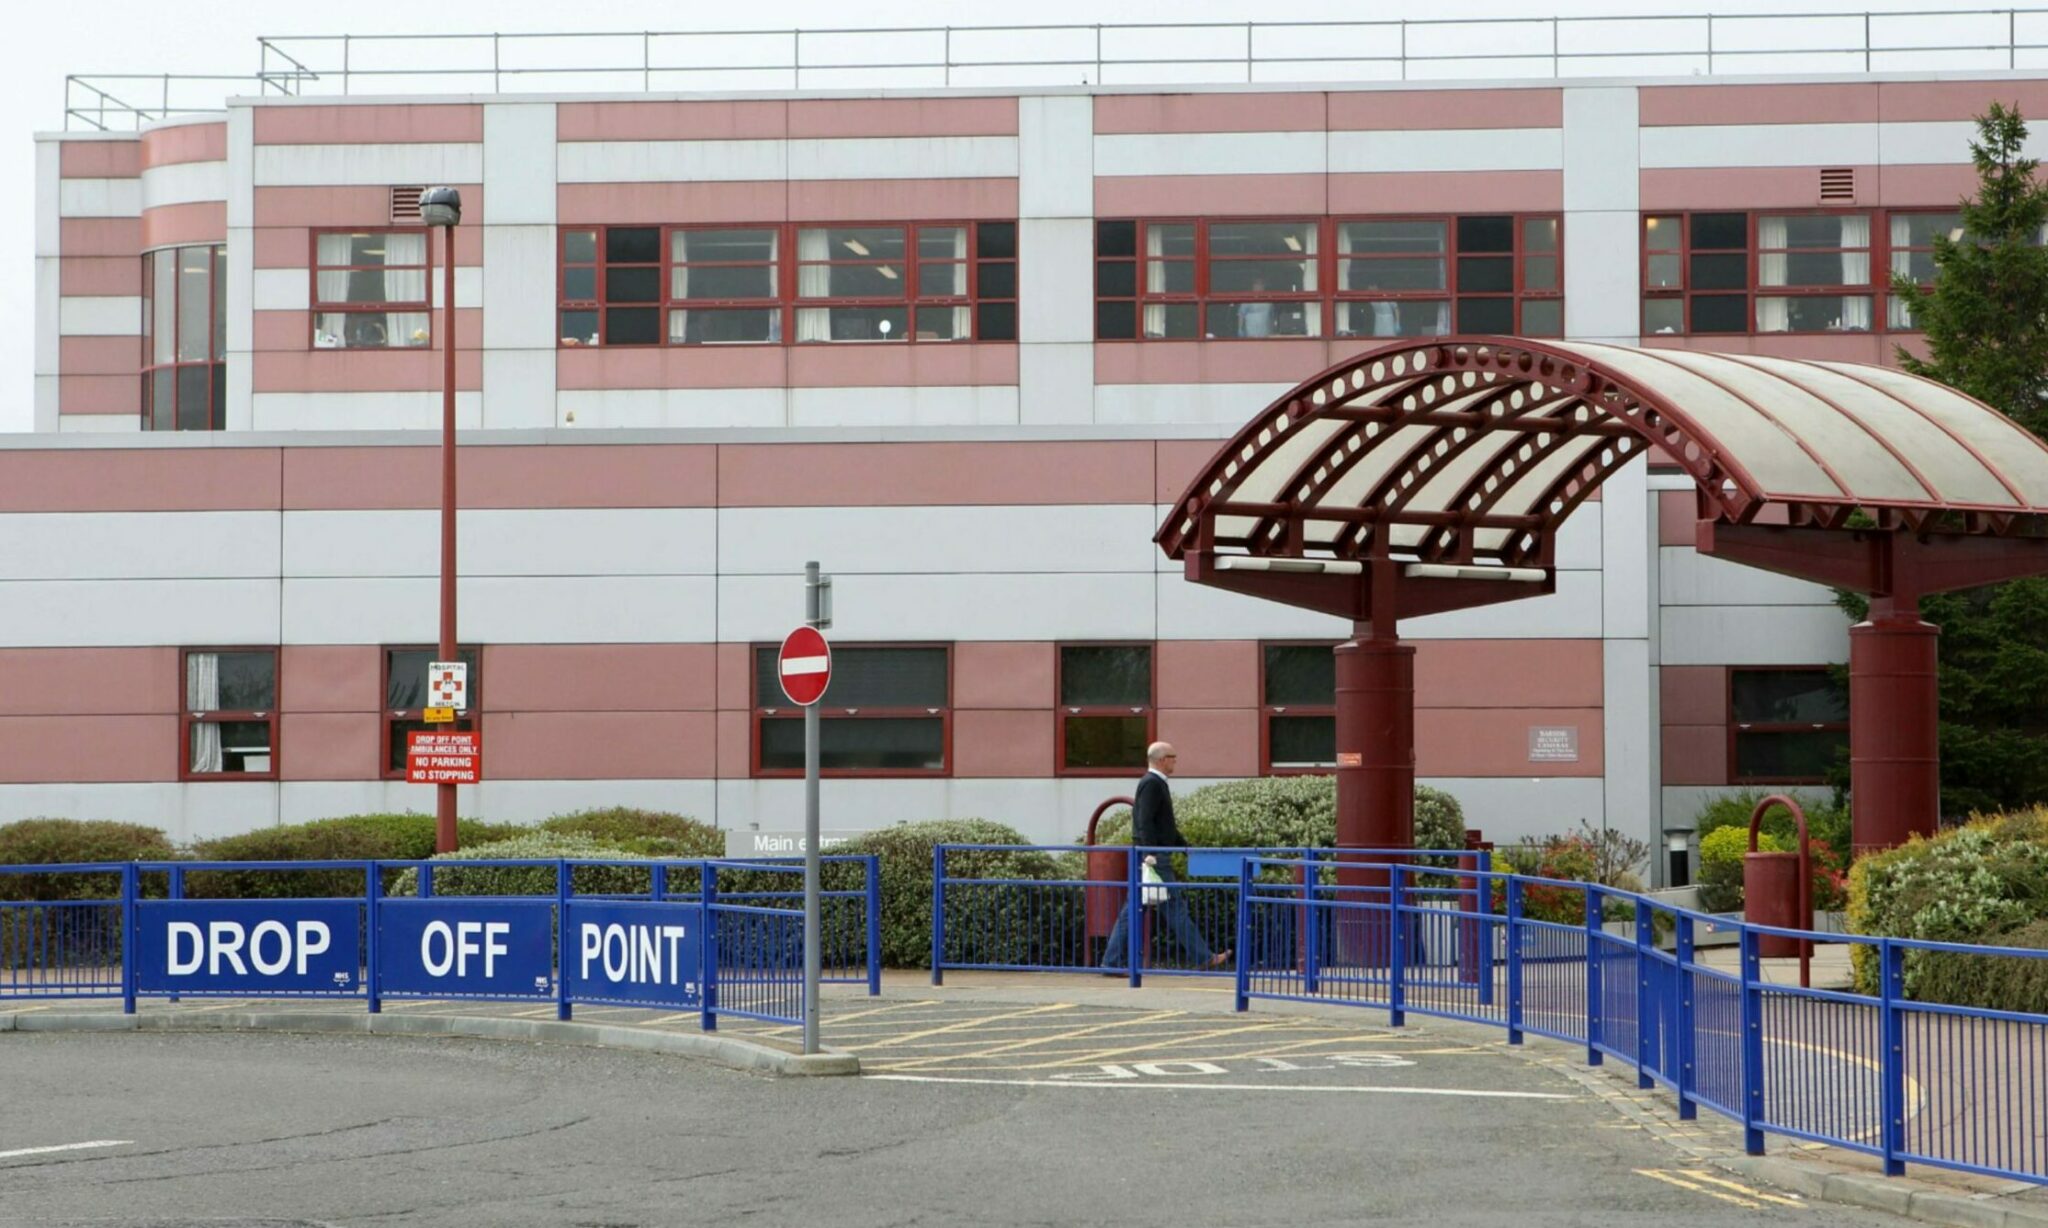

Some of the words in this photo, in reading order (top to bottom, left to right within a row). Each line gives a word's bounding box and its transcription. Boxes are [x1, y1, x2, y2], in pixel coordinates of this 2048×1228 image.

[415, 735, 435, 744] DROP
[436, 736, 450, 744] OFF
[451, 736, 473, 744] POINT
[411, 745, 457, 753] AMBULANCES
[415, 757, 429, 767] NO
[431, 757, 473, 768] PARKING
[412, 770, 426, 779] NO
[427, 770, 474, 780] STOPPING
[754, 834, 793, 851] Main
[167, 920, 331, 976] DROP
[421, 920, 510, 978] OFF
[581, 922, 685, 985] POINT
